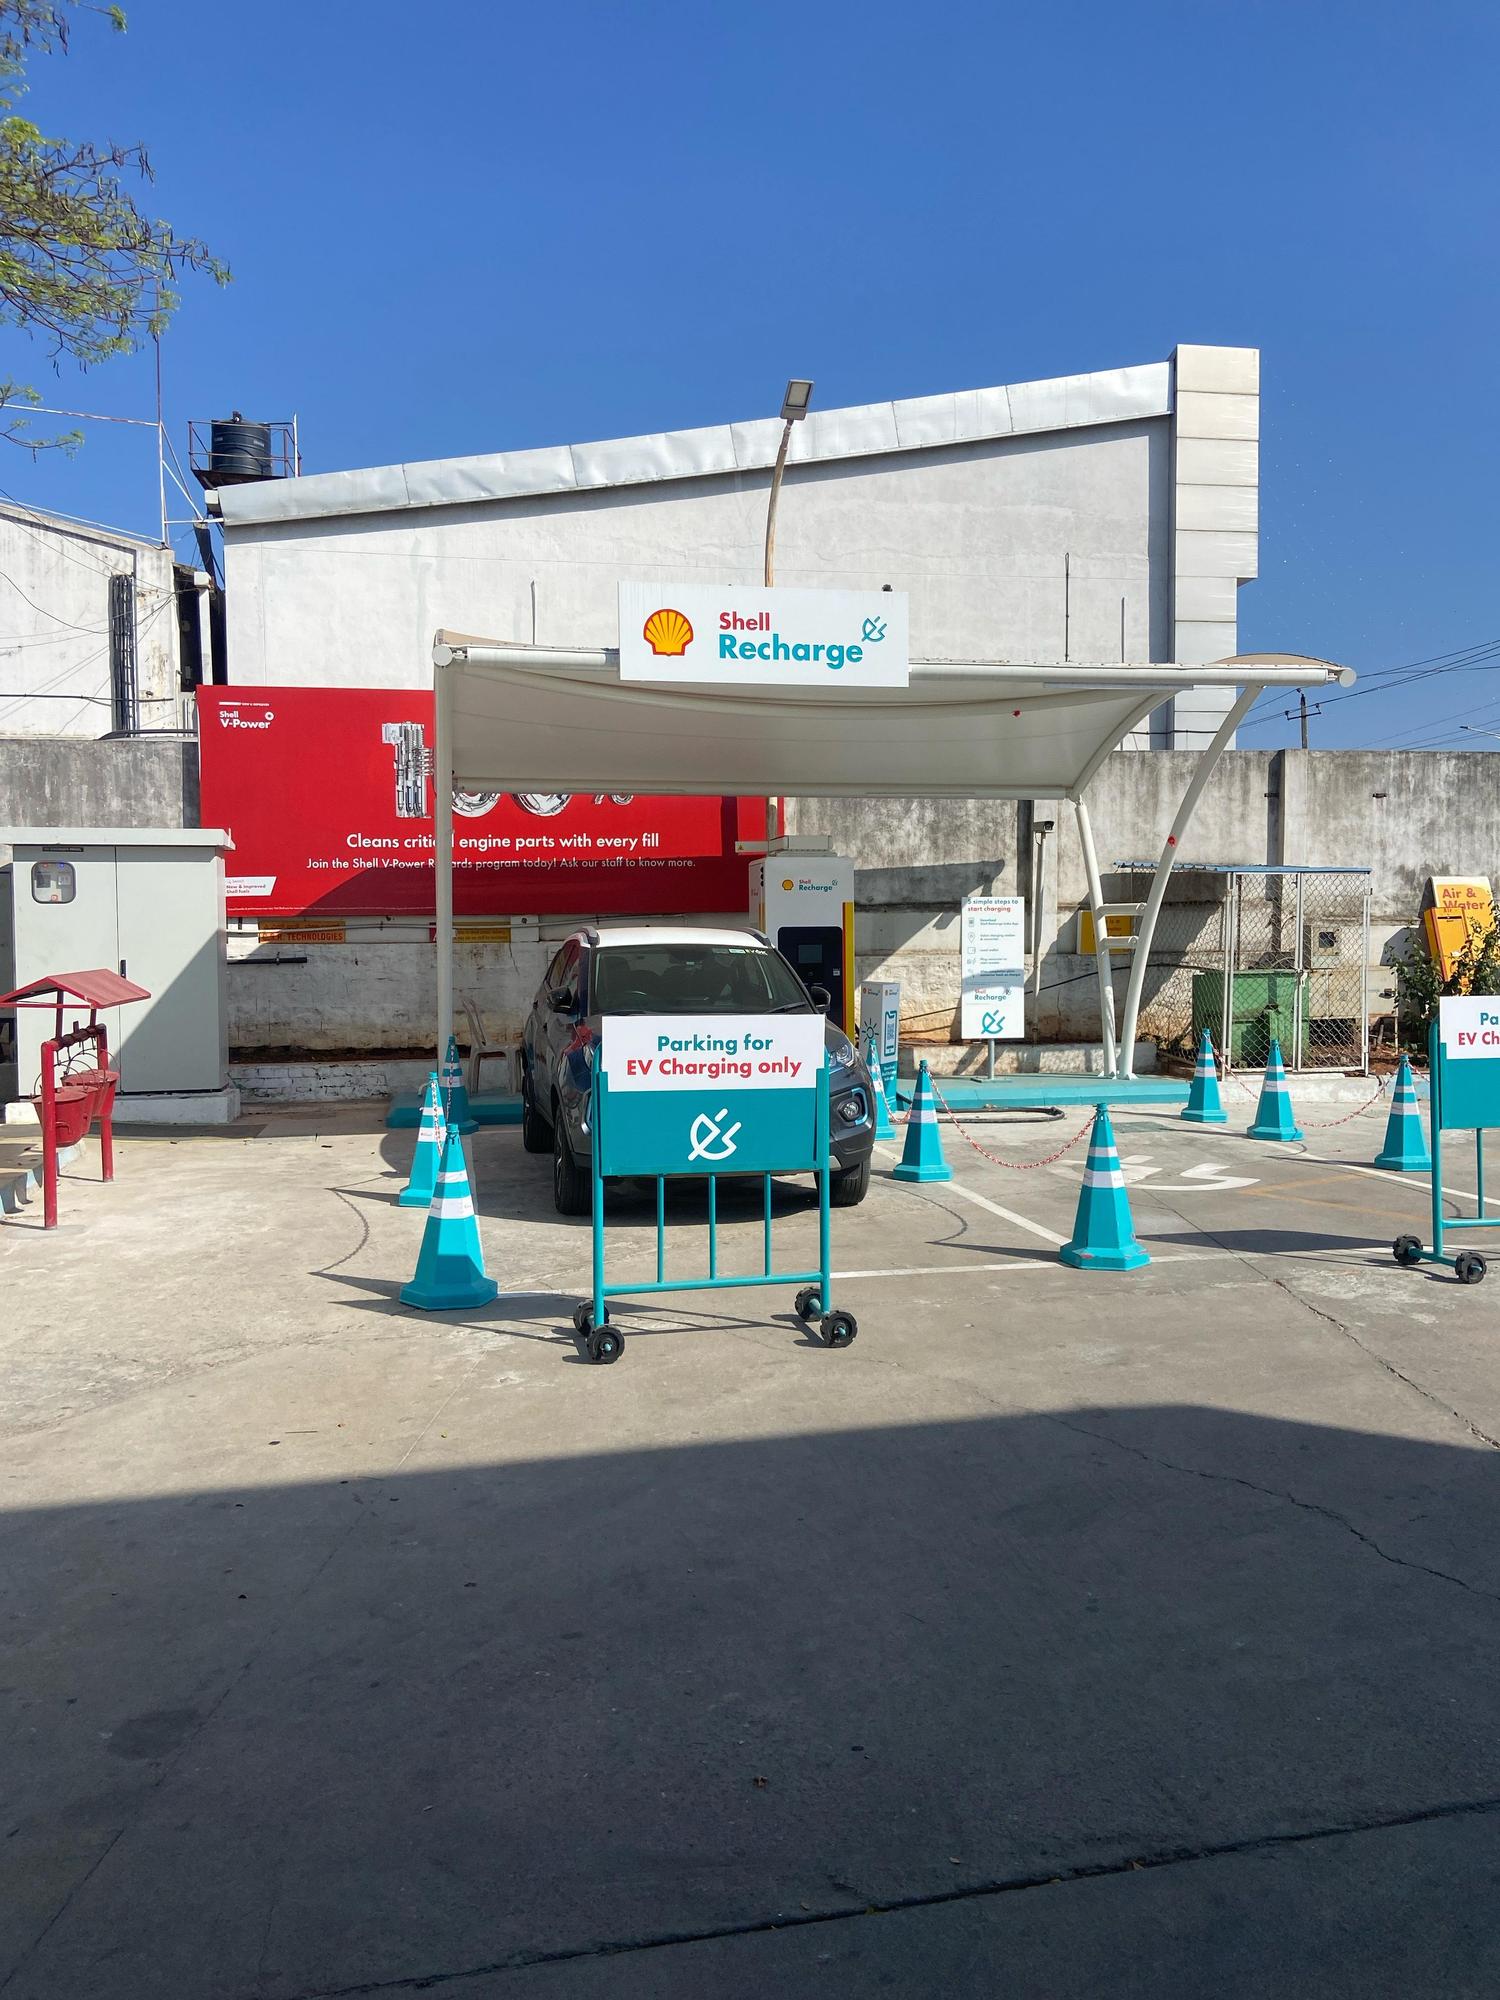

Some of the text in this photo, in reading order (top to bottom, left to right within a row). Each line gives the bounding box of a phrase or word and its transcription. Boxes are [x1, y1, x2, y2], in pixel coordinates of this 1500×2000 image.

[719, 611, 770, 631] Shell
[719, 633, 863, 670] Recharge
[219, 710, 239, 718] Shell
[220, 718, 271, 729] V-Power
[346, 832, 659, 851] Cleans critil engine parts with every fill
[306, 856, 696, 871] Join the Shell V-Power Rards program today! Ask our staff to know more.
[798, 884, 833, 892] Recharge
[1442, 887, 1477, 899] Air &
[973, 898, 993, 906] simple
[288, 931, 343, 941] TECHNOLOGIES
[974, 994, 1007, 1002] Recharge
[657, 1033, 773, 1056] Parking for
[1458, 1032, 1477, 1046] EV
[626, 1056, 802, 1079] EV Charging only
